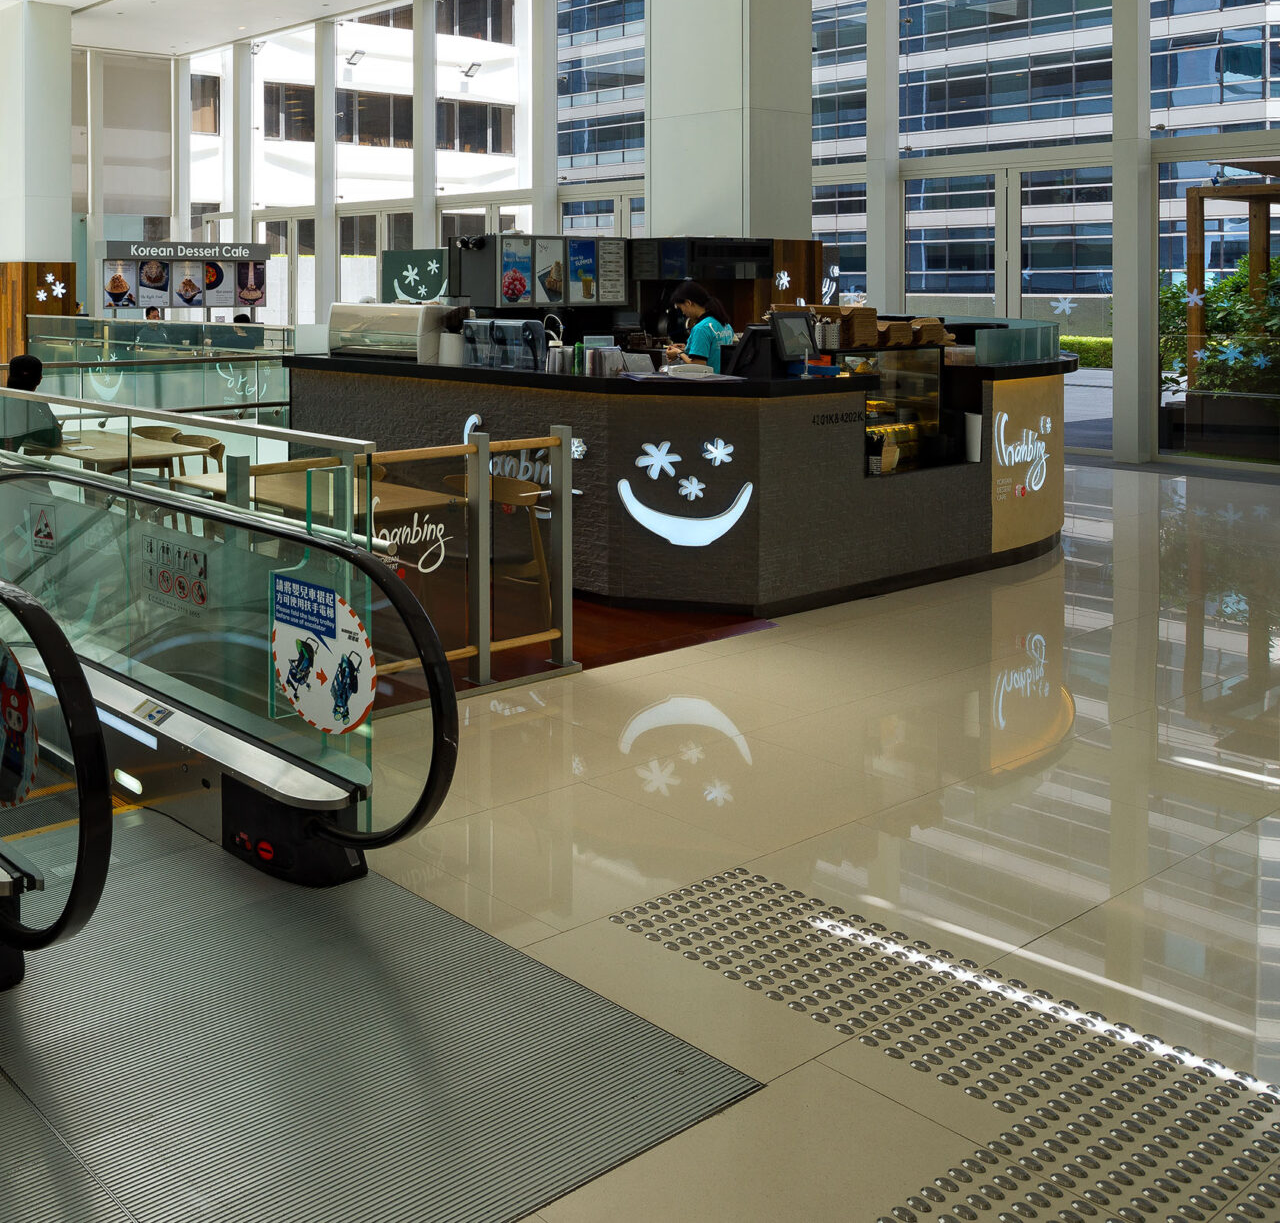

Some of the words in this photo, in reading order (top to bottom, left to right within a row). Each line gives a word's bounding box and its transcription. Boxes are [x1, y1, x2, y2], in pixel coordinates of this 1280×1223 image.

[130, 245, 174, 257] Korean
[177, 246, 219, 257] Dessert
[222, 246, 250, 257] Cafe
[372, 496, 454, 573] hanbing
[275, 611, 290, 620] before
[275, 604, 290, 614] Please
[291, 609, 300, 617] fold
[308, 614, 320, 624] baby
[319, 618, 335, 629] trolley
